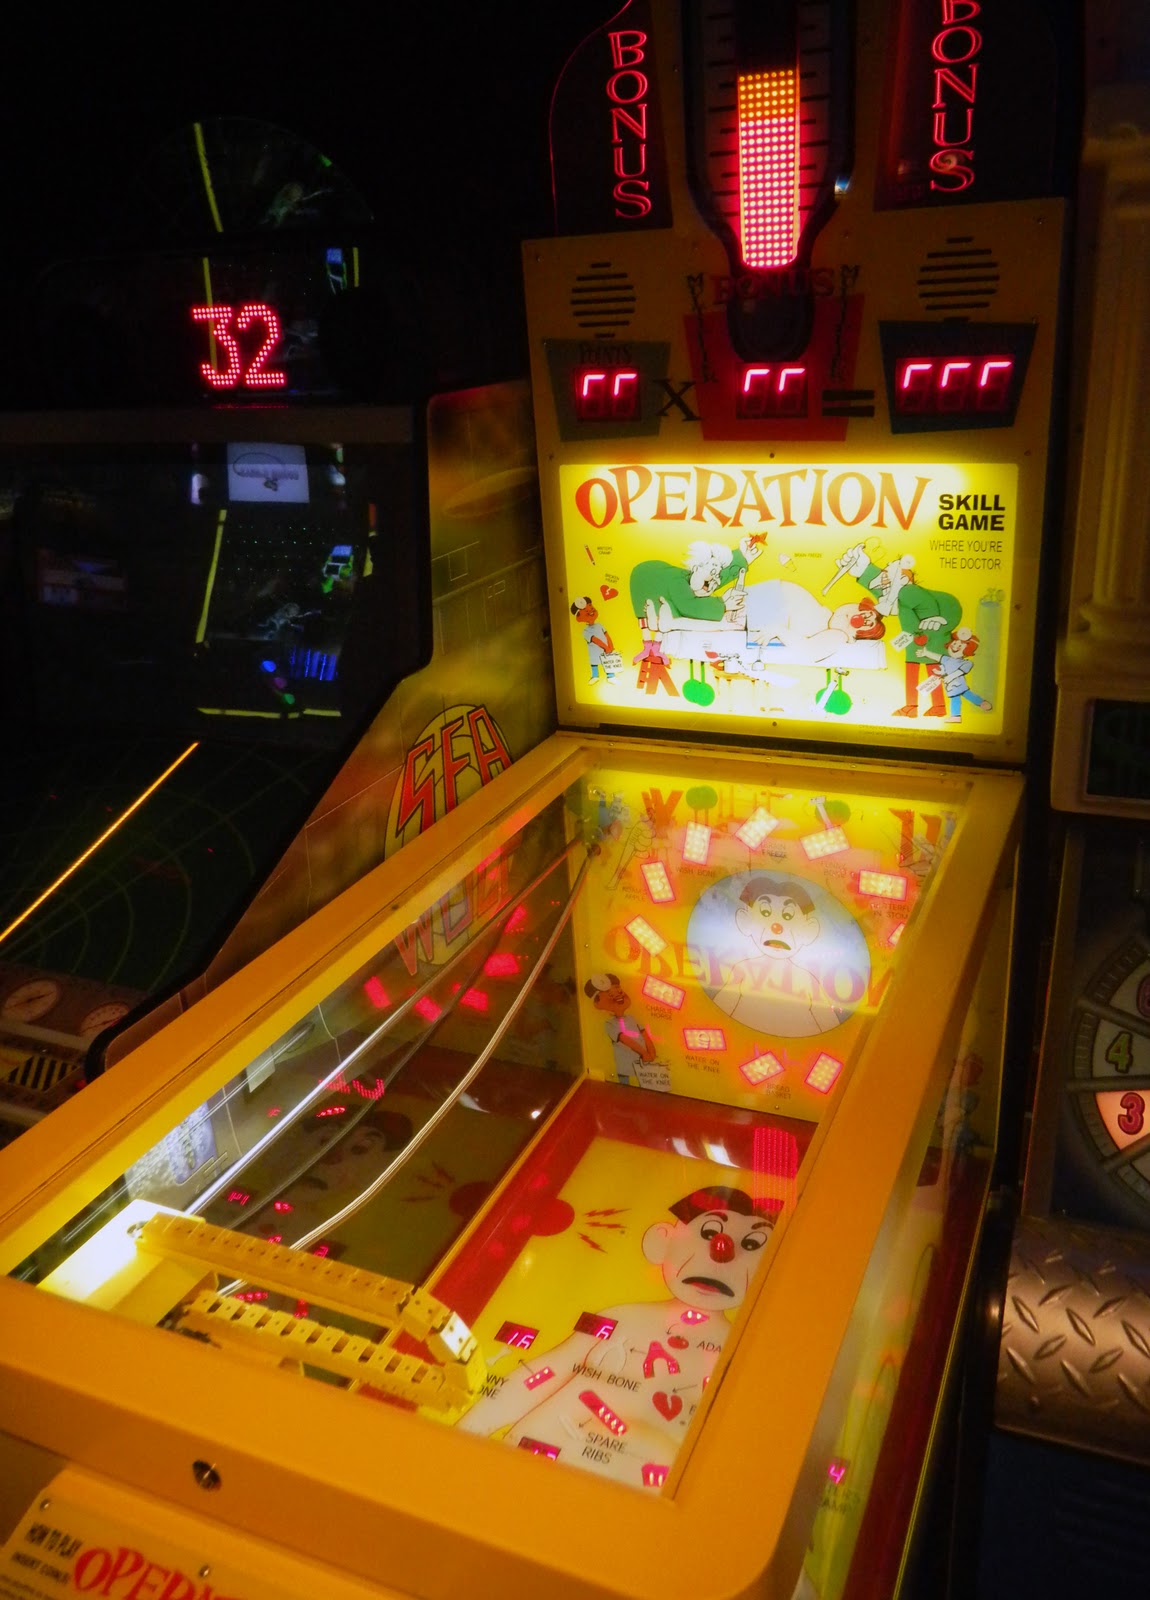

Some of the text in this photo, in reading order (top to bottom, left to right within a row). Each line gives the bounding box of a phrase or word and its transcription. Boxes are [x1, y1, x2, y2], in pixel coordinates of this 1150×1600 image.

[930, 0, 983, 193] BONUS
[607, 30, 652, 218] BONUS
[192, 304, 286, 388] 32
[575, 464, 932, 531] OPERATION
[938, 493, 1006, 511] SKILL
[938, 513, 1005, 532] GAME
[929, 539, 1003, 553] WHERE YOU'RE
[939, 557, 1002, 570] THE DOCTOR
[685, 1054, 709, 1063] WATER
[1105, 1031, 1134, 1074] 4
[1117, 1091, 1145, 1136] 3
[697, 1340, 722, 1353] ADA
[572, 1363, 642, 1393] WISH BONE
[585, 1432, 628, 1454] SPARE
[582, 1446, 613, 1465] RIBS
